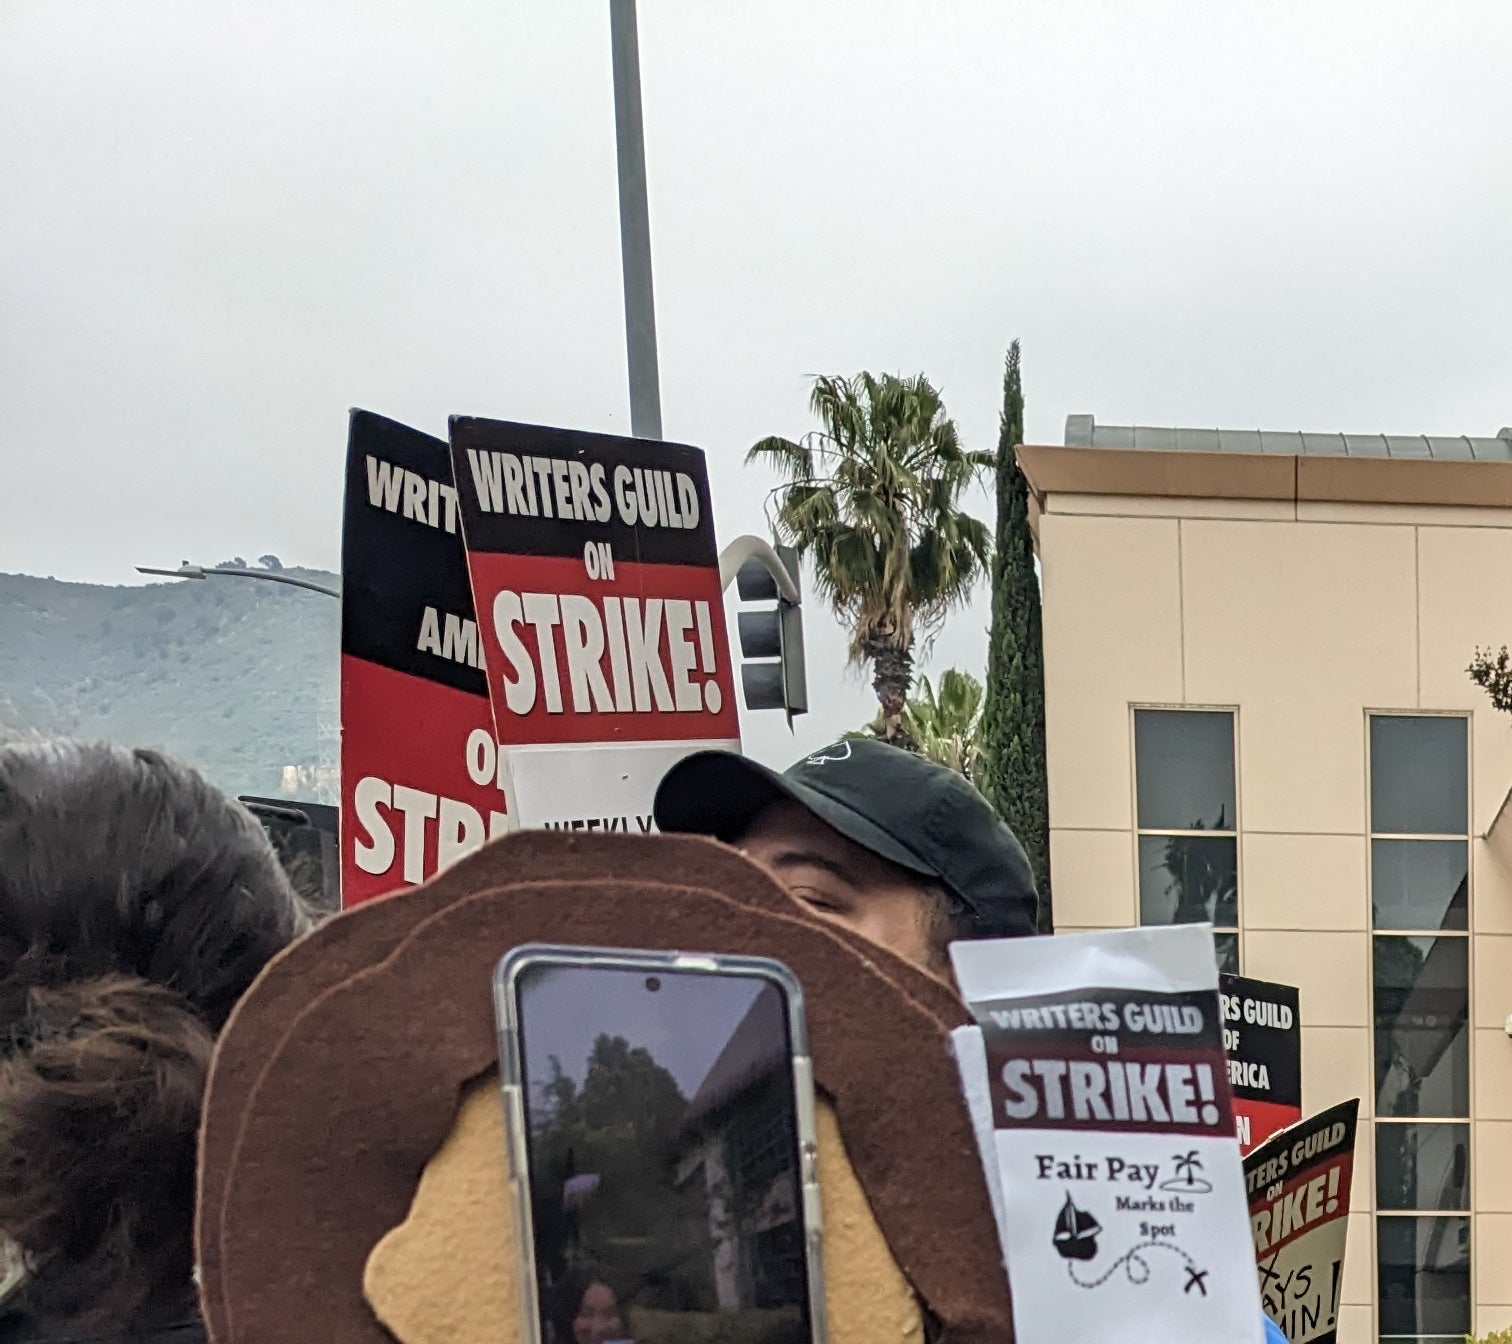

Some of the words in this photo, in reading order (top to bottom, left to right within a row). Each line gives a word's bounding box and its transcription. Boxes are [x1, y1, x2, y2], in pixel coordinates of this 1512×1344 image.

[366, 455, 457, 533] WRIT
[467, 449, 612, 524] WRITERS
[614, 464, 699, 530] GUILD
[584, 541, 615, 580] ON
[493, 590, 722, 715] STRIKE!
[355, 776, 507, 884] STR
[990, 1003, 1120, 1031] WRITERS
[1124, 1002, 1203, 1034] GUILD
[1244, 998, 1293, 1030] GUILD
[1091, 1035, 1119, 1054] ON
[1224, 1029, 1239, 1050] OF
[1002, 1058, 1219, 1125] STRIKE!
[1291, 1122, 1346, 1166] GUILD
[1035, 1154, 1098, 1180] Fair
[1106, 1157, 1160, 1189] Pay
[1115, 1196, 1166, 1212] Marks
[1170, 1196, 1194, 1213] the
[1266, 1180, 1284, 1202] ON
[1140, 1222, 1176, 1239] Spot
